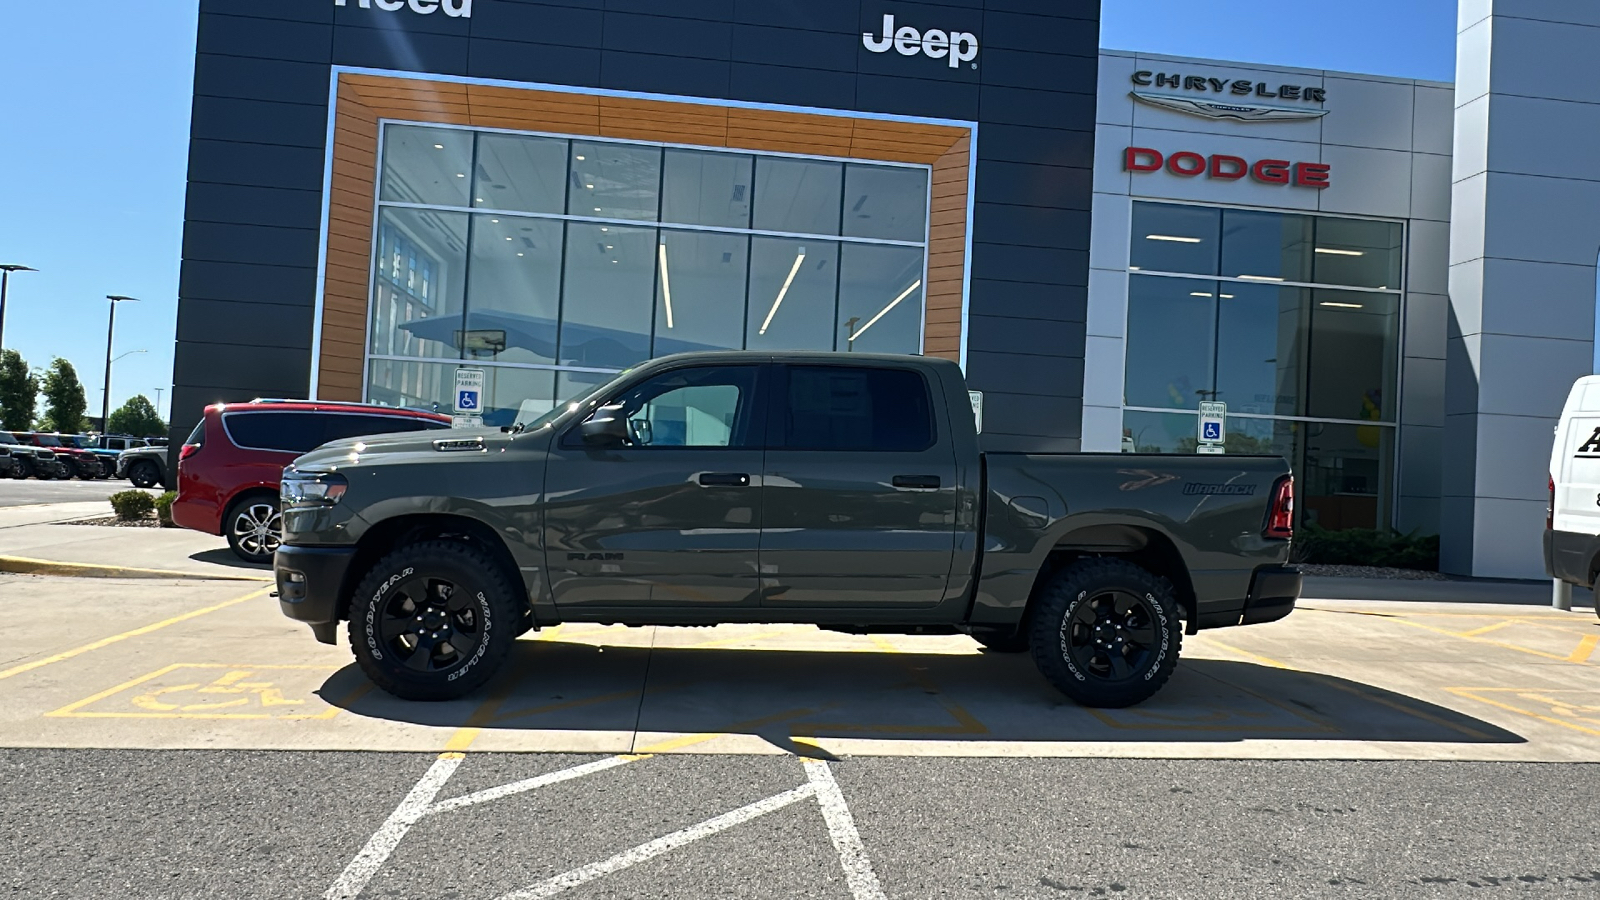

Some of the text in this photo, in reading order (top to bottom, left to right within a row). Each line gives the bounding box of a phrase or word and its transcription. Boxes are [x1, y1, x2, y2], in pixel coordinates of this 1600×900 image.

[863, 14, 978, 68] Jeep
[1131, 70, 1327, 101] CHRYSLER
[1125, 146, 1330, 189] DODGE
[1182, 483, 1256, 495] WARLOCK
[567, 552, 624, 560] RAM
[448, 591, 492, 681] WRANGLER
[1145, 592, 1169, 681] WRANGLER
